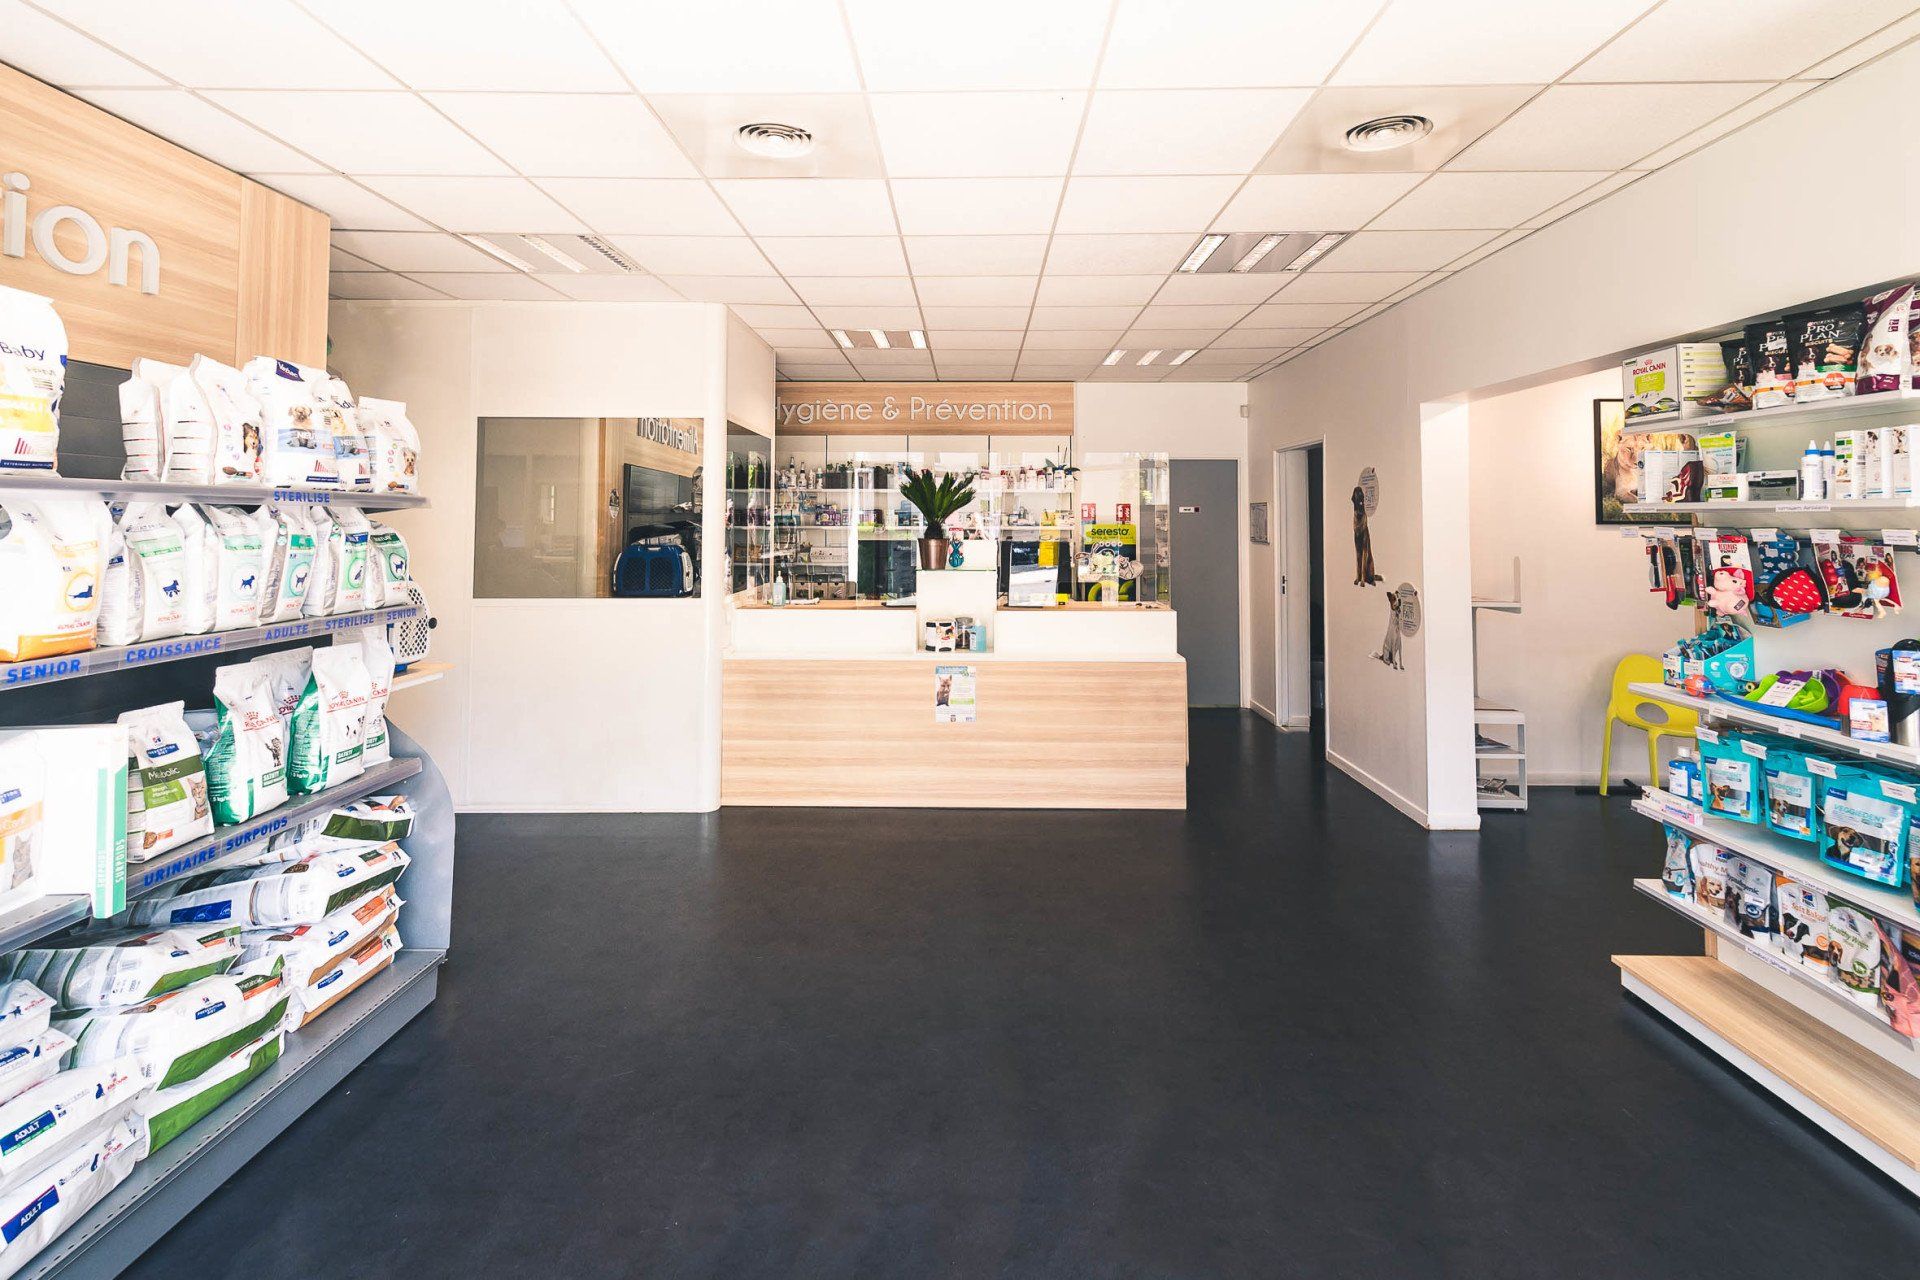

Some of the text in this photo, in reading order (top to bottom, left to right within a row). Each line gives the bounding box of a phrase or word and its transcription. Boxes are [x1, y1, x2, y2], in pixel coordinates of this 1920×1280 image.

[0, 172, 160, 295] ion
[1800, 329, 1841, 344] PLAN
[1807, 323, 1835, 335] PRO
[0, 341, 45, 361] Baby
[1632, 366, 1649, 376] ROYAL
[1649, 361, 1667, 373] CANIN
[882, 396, 900, 421] &
[910, 396, 1052, 421] Prévention
[274, 490, 331, 503] STERILISE
[325, 614, 375, 631] STERILISE
[387, 607, 417, 621] SENIOR
[265, 624, 309, 641] ADULTE
[126, 637, 222, 664] CROISSANCE
[7, 658, 81, 684] SENIOR
[1834, 803, 1886, 823] VEGGIEDENT
[225, 816, 288, 851] SURPOIDS
[115, 838, 125, 884] SURPOIDS
[143, 845, 217, 887] URINAIRE
[14, 1120, 42, 1142] ADULT
[20, 1201, 43, 1227] ADULT
